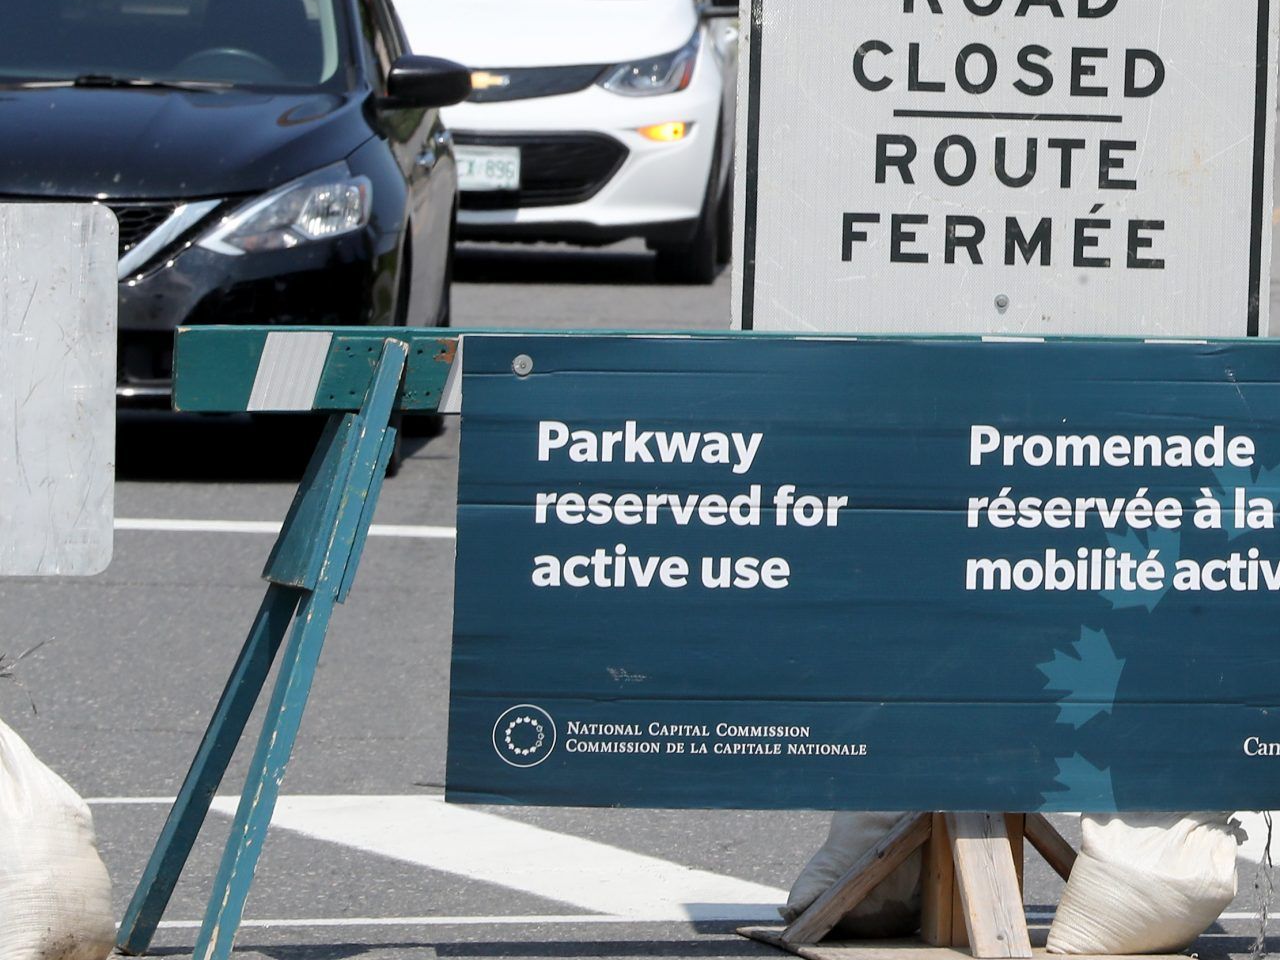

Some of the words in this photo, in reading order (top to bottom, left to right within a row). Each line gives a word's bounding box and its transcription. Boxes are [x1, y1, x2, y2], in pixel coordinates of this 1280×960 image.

[852, 39, 1166, 98] CLOSED
[875, 133, 1138, 191] ROUTE
[841, 203, 1166, 270] FERMÉE
[537, 420, 764, 474] Parkway
[968, 424, 1256, 468] Promenade
[535, 484, 762, 526] reserved
[773, 484, 849, 527] for
[967, 486, 1184, 530] réservée
[1193, 487, 1222, 530] à
[1234, 487, 1275, 530] la
[531, 543, 690, 588] active
[701, 556, 791, 589] use
[965, 546, 1166, 591] mobilité
